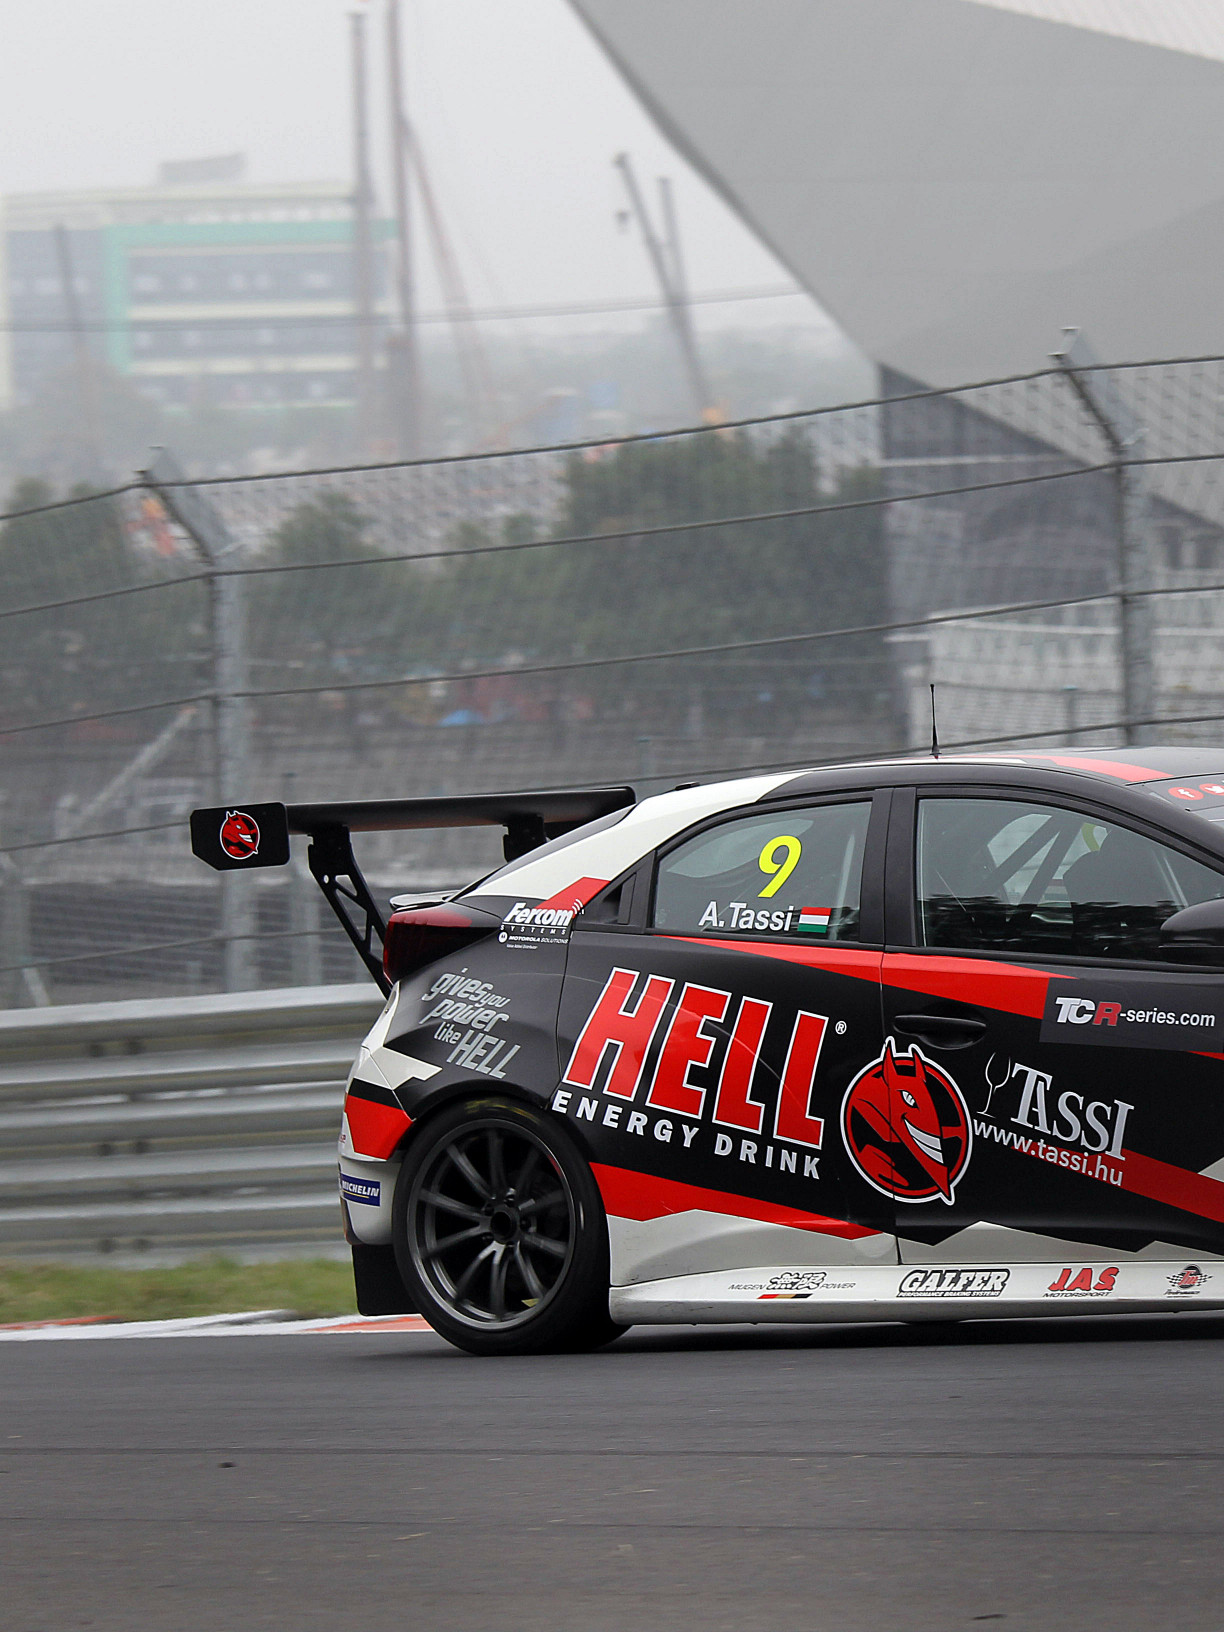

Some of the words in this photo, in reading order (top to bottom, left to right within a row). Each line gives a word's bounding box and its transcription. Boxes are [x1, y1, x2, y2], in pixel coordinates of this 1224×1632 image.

[757, 835, 802, 898] 9
[500, 924, 566, 935] SYSTEMS
[503, 902, 573, 926] Fercom
[699, 901, 794, 931] A.Tassi
[421, 967, 493, 1001] gives
[475, 993, 511, 1008] you
[419, 999, 510, 1032] power
[1055, 996, 1216, 1027] TCR-series.com
[434, 1022, 461, 1044] like
[446, 1029, 521, 1079] HELL
[1010, 1062, 1135, 1161] TASSI
[552, 1090, 699, 1148] ENERGY
[714, 1133, 820, 1180] DRINK
[973, 1118, 1124, 1187] www.tassi.hu
[342, 1180, 380, 1197] MICHELIN
[899, 1268, 1010, 1291] GALFER
[1047, 1266, 1120, 1291] JAS
